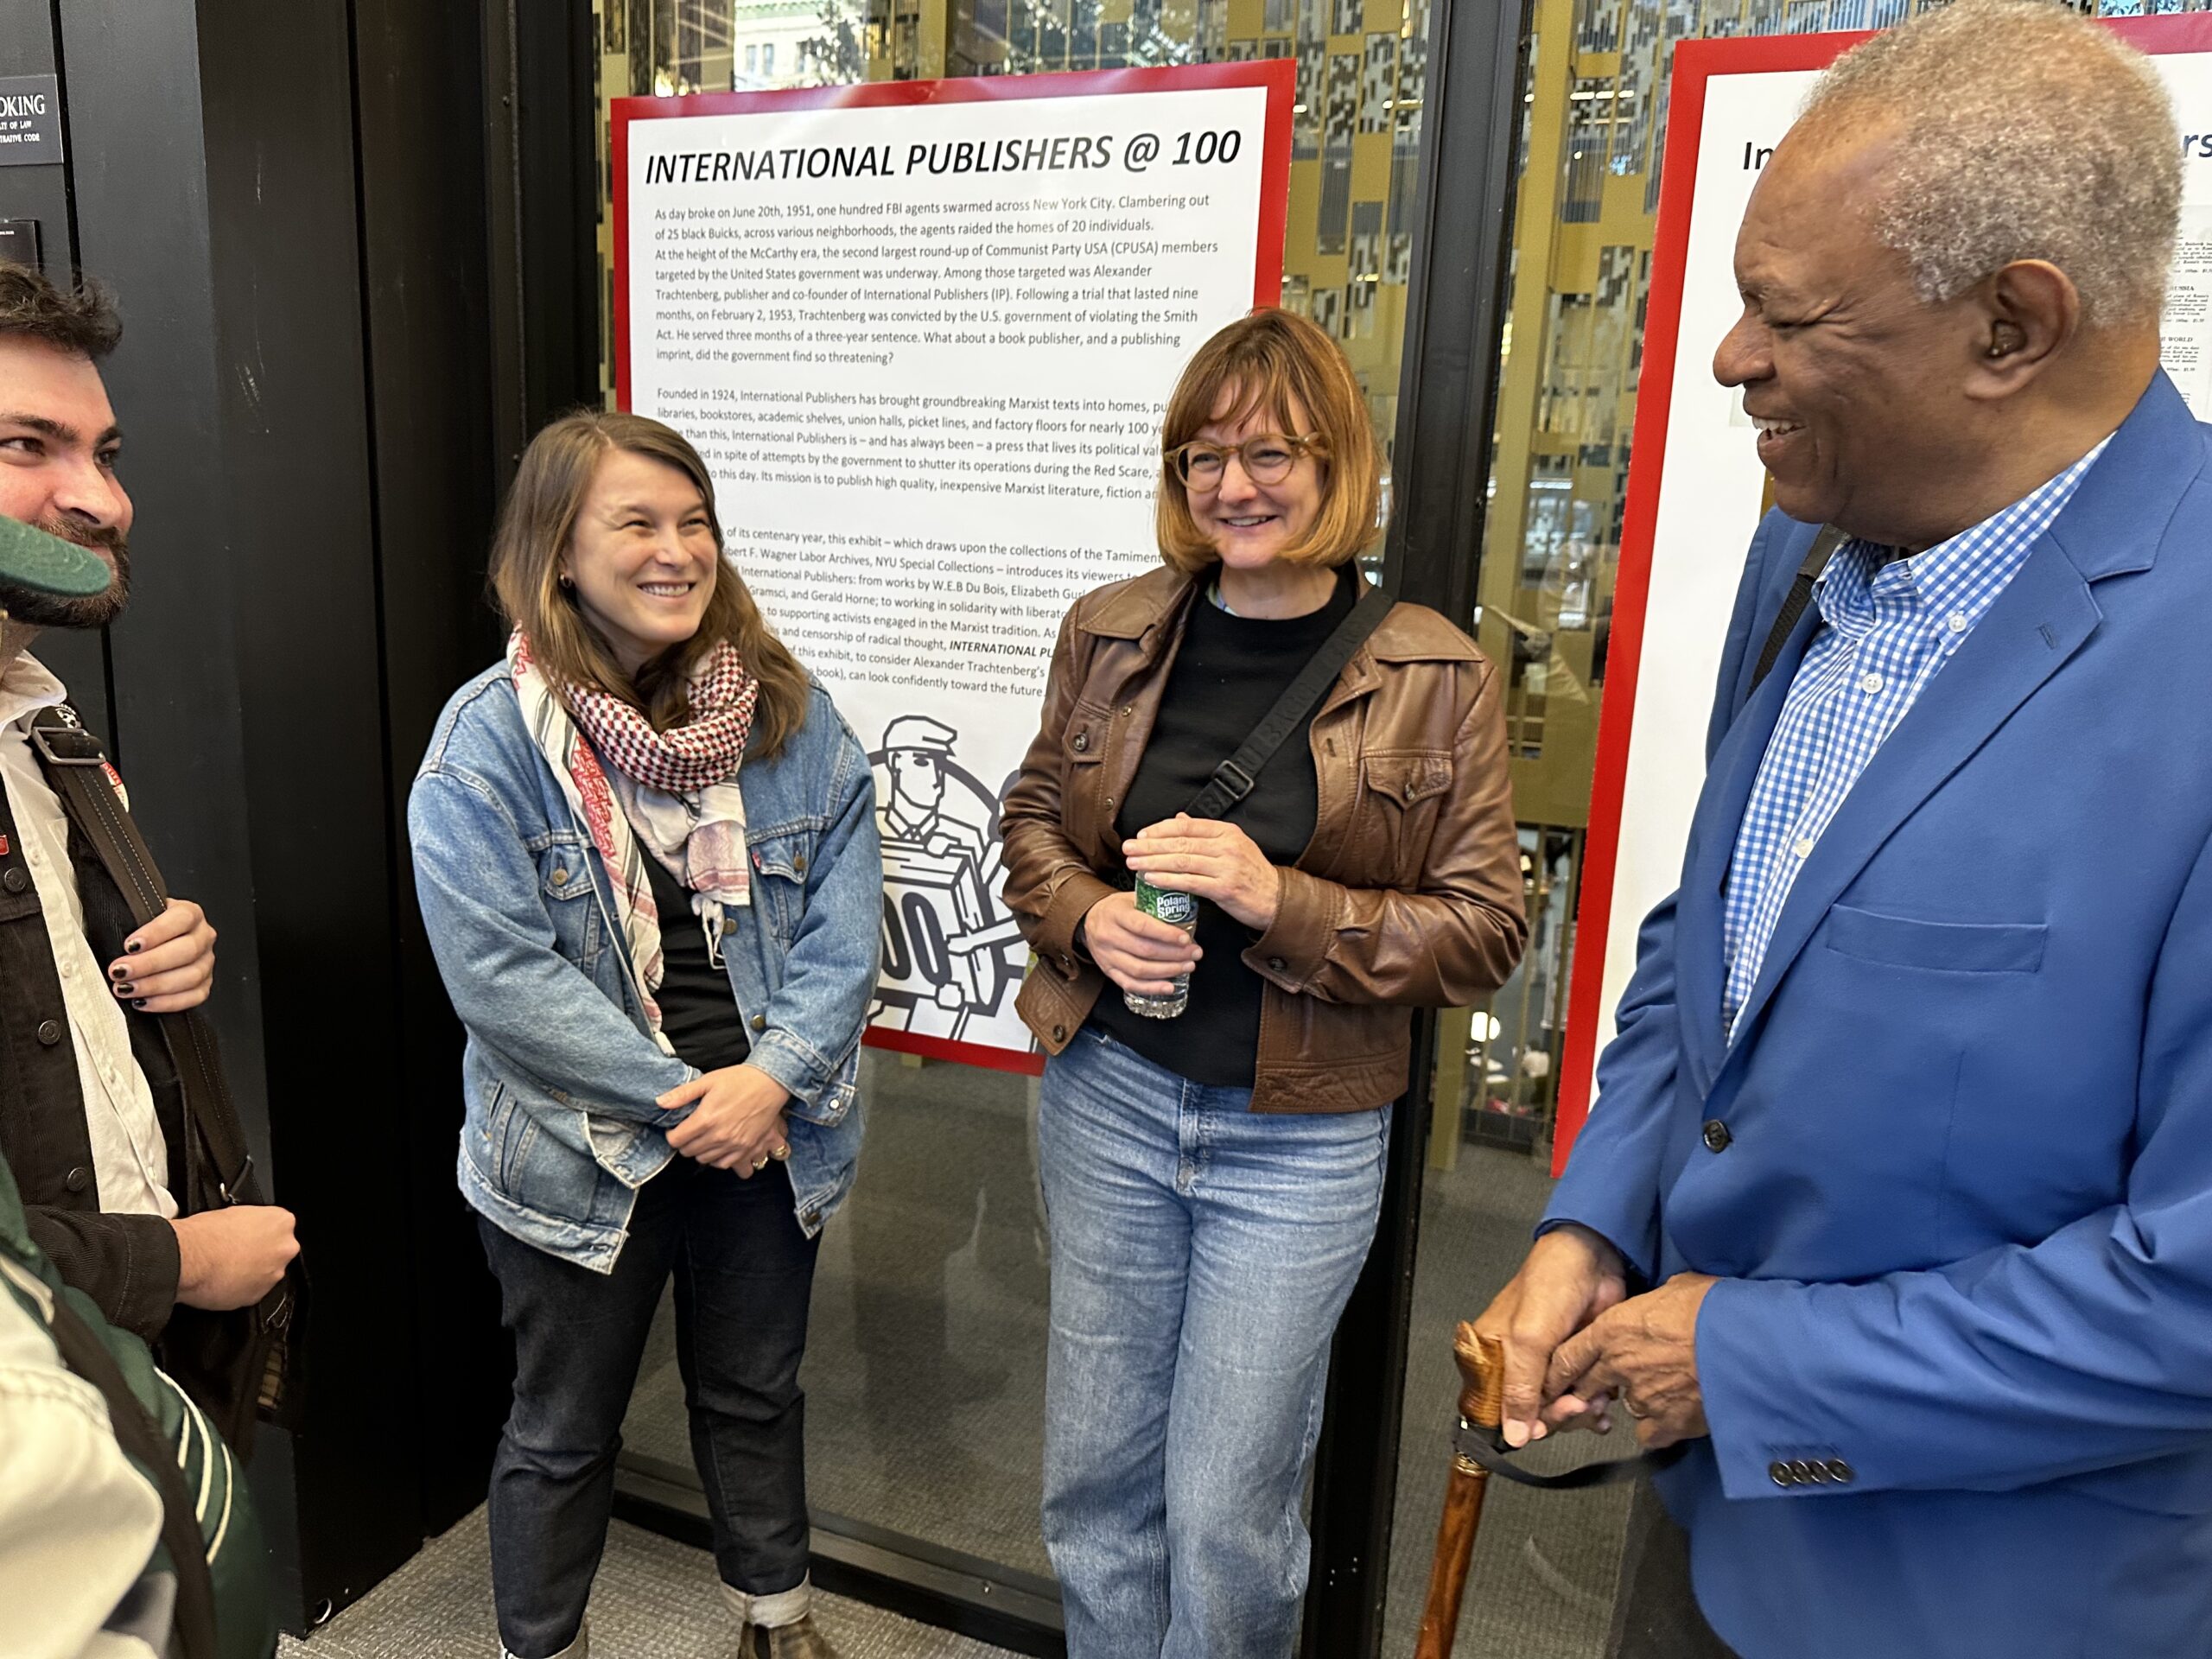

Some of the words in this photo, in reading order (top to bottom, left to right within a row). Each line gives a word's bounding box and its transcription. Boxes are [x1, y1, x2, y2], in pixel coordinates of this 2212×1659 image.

[20, 120, 32, 130] LAW
[646, 145, 894, 184] INTERNATIONAL
[906, 135, 1113, 175] PUBLISHERS
[1123, 132, 1160, 173] @
[1172, 130, 1242, 166] 100
[654, 208, 667, 220] As
[668, 207, 686, 222] day
[688, 207, 715, 219] broke
[717, 209, 731, 219] on
[732, 207, 755, 219] June
[758, 205, 784, 219] 20th,
[786, 205, 814, 218] 1951,
[817, 207, 836, 216] one
[839, 202, 883, 216] hundred
[886, 202, 902, 215] FBI
[905, 203, 940, 217] agents
[943, 200, 993, 213] swarmed
[995, 201, 1030, 212] across
[1033, 199, 1058, 210] New
[1061, 198, 1087, 210] York
[1090, 197, 1116, 212] City.
[1118, 195, 1186, 210] Clambering
[1189, 194, 1210, 207] out
[655, 228, 665, 240] of
[667, 228, 679, 240] 25
[681, 227, 707, 240] black
[709, 227, 741, 240] Buicks,
[743, 229, 775, 238] across
[777, 226, 814, 238] various
[816, 224, 897, 240] neighborhoods,
[899, 224, 918, 236] the
[919, 224, 956, 238] agents
[957, 222, 993, 235] raided
[995, 222, 1014, 234] the
[1016, 221, 1054, 233] homes
[1057, 220, 1069, 232] of
[1071, 220, 1087, 232] 20
[1089, 219, 1154, 232] individuals.
[655, 249, 666, 261] At
[667, 249, 684, 260] the
[686, 248, 717, 263] height
[718, 247, 729, 260] of
[731, 247, 747, 259] the
[750, 246, 798, 261] McCarthy
[800, 249, 820, 260] era,
[823, 246, 840, 258] the
[842, 245, 879, 258] second
[881, 245, 917, 260] largest
[919, 245, 969, 259] round-up
[971, 245, 983, 257] of
[985, 244, 1049, 257] Communist
[1052, 243, 1082, 257] Party
[1084, 243, 1108, 255] USA
[1111, 242, 1159, 257] (CPUSA)
[1161, 241, 1218, 253] members
[655, 269, 696, 283] targeted
[697, 268, 710, 283] by
[712, 268, 728, 280] the
[730, 268, 764, 280] United
[766, 268, 797, 280] States
[798, 269, 861, 283] government
[862, 270, 883, 279] was
[885, 267, 941, 281] underway.
[944, 267, 982, 281] Among
[985, 266, 1015, 278] those
[1018, 265, 1066, 281] targeted
[1068, 268, 1090, 277] was
[1093, 265, 1153, 277] Alexander
[655, 289, 721, 303] Trachtenberg,
[723, 289, 769, 302] publisher
[771, 289, 790, 301] and
[792, 289, 849, 301] co-founder
[850, 289, 861, 301] of
[864, 289, 931, 301] International
[933, 289, 988, 301] Publishers
[991, 289, 1013, 302] (IP).
[1016, 289, 1070, 302] Following
[1071, 290, 1078, 300] a
[1082, 288, 1104, 300] trial
[1108, 288, 1131, 300] that
[1134, 288, 1170, 300] lasted
[1173, 288, 1198, 300] nine
[657, 387, 698, 400] Founded
[700, 389, 709, 400] in
[712, 389, 738, 403] 1924,
[740, 390, 804, 403] International
[805, 391, 857, 404] Publishers
[859, 393, 877, 405] has
[879, 393, 920, 409] brought
[922, 395, 1006, 411] groundbreaking
[1008, 397, 1050, 410] Marxist
[1052, 399, 1080, 411] texts
[1083, 398, 1105, 411] into
[1108, 399, 1150, 414] homes,
[658, 407, 697, 421] libraries,
[700, 408, 756, 423] bookstores,
[757, 410, 804, 423] academic
[805, 412, 845, 427] shelves,
[848, 414, 877, 426] union
[879, 415, 906, 429] halls,
[908, 416, 939, 429] picket
[942, 416, 969, 431] lines,
[971, 417, 992, 429] and
[995, 417, 1033, 434] factory
[1035, 419, 1068, 432] floors
[1070, 420, 1087, 433] for
[1089, 421, 1125, 436] nearly
[1128, 422, 1149, 435] 100
[726, 526, 737, 537] of
[738, 527, 751, 539] its
[752, 531, 800, 544] centenary
[801, 534, 826, 545] year,
[828, 533, 847, 545] this
[849, 535, 882, 548] exhibit
[893, 537, 924, 550] which
[925, 539, 957, 552] draws
[959, 543, 987, 556] upon
[988, 543, 1007, 556] the
[1009, 544, 1067, 559] collections
[1070, 547, 1082, 559] of
[1084, 548, 1103, 561] the
[767, 607, 778, 617] to
[779, 608, 830, 624] supporting
[832, 612, 871, 625] activists
[873, 617, 916, 630] engaged
[918, 618, 928, 629] in
[930, 619, 948, 631] the
[950, 620, 989, 634] Marxist
[991, 624, 1041, 638] tradition.
[1043, 628, 1057, 639] As
[816, 666, 848, 681] book),
[849, 671, 866, 681] can
[868, 671, 890, 683] look
[892, 674, 949, 690] confidently
[950, 679, 988, 692] toward
[990, 682, 1007, 694] the
[1156, 893, 1190, 908] Poland
[1156, 903, 1191, 918] Spring
